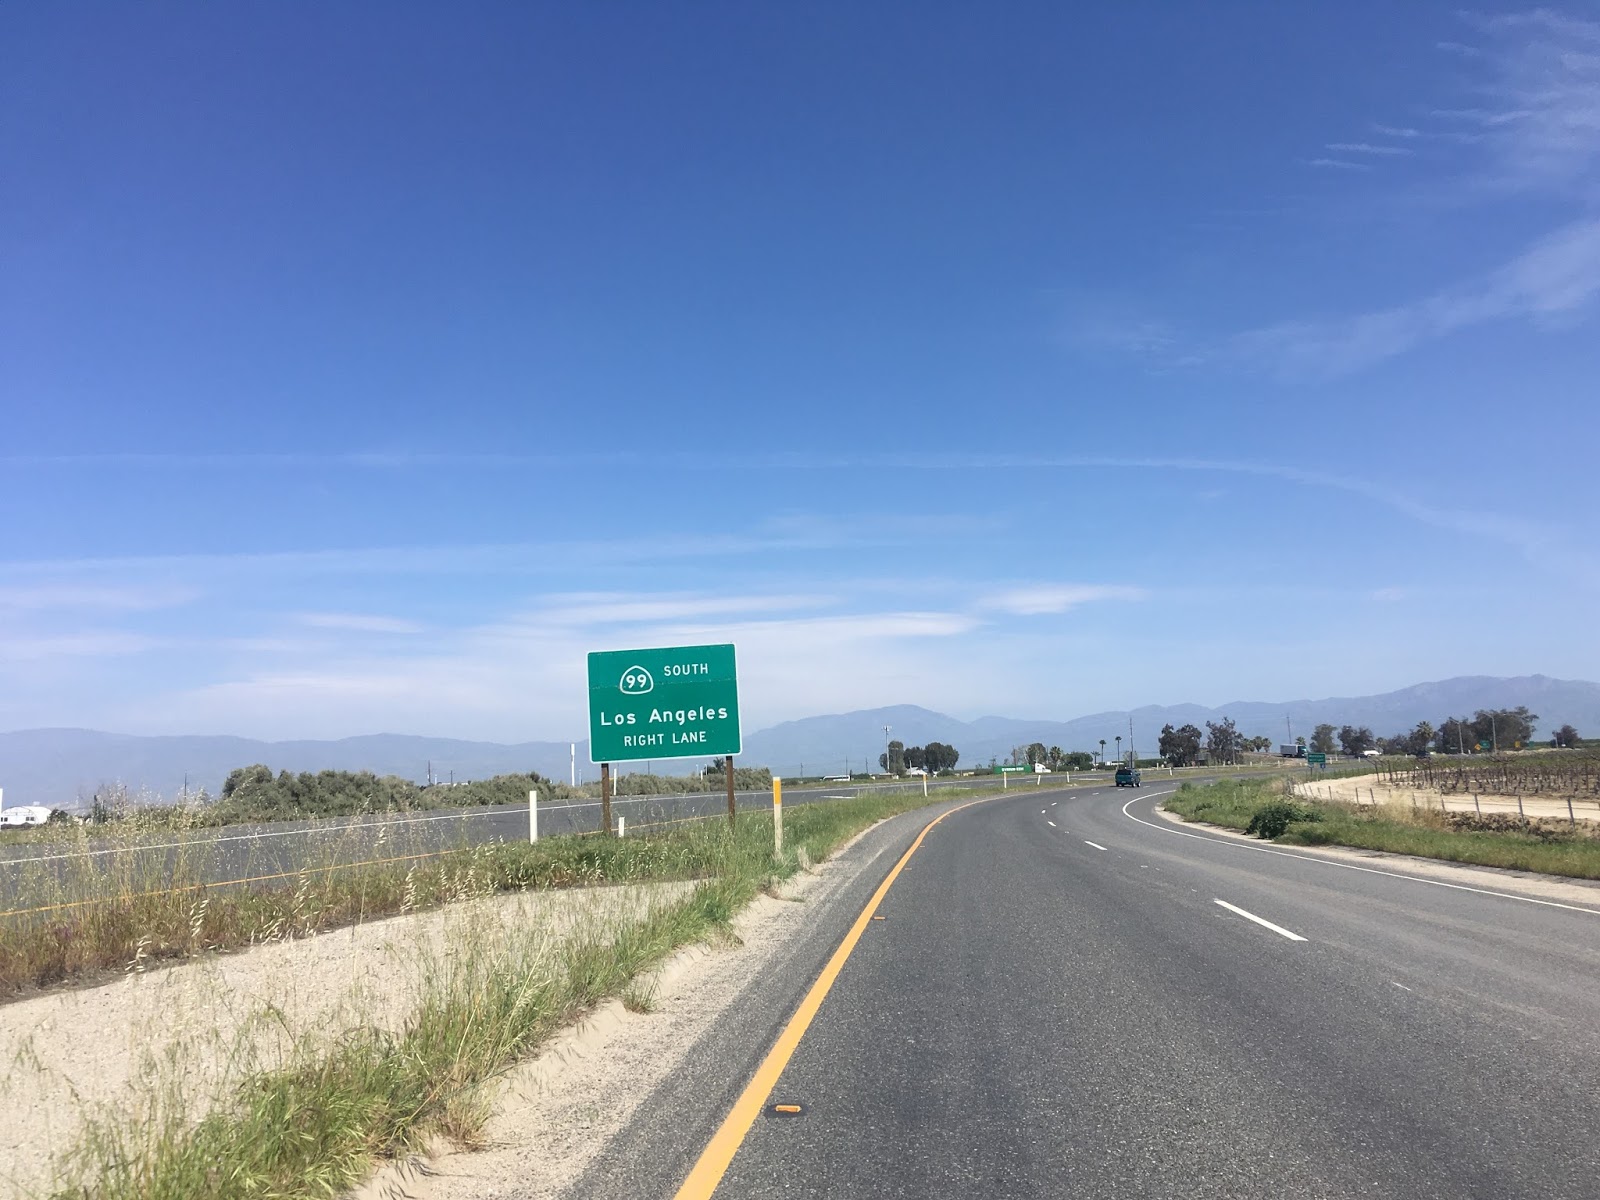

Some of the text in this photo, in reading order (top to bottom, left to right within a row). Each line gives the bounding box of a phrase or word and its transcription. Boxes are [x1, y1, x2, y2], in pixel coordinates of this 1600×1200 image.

[625, 663, 709, 689] 99 SOUTH
[600, 706, 728, 726] Los Angeles
[624, 731, 707, 747] RIGHT LANE
